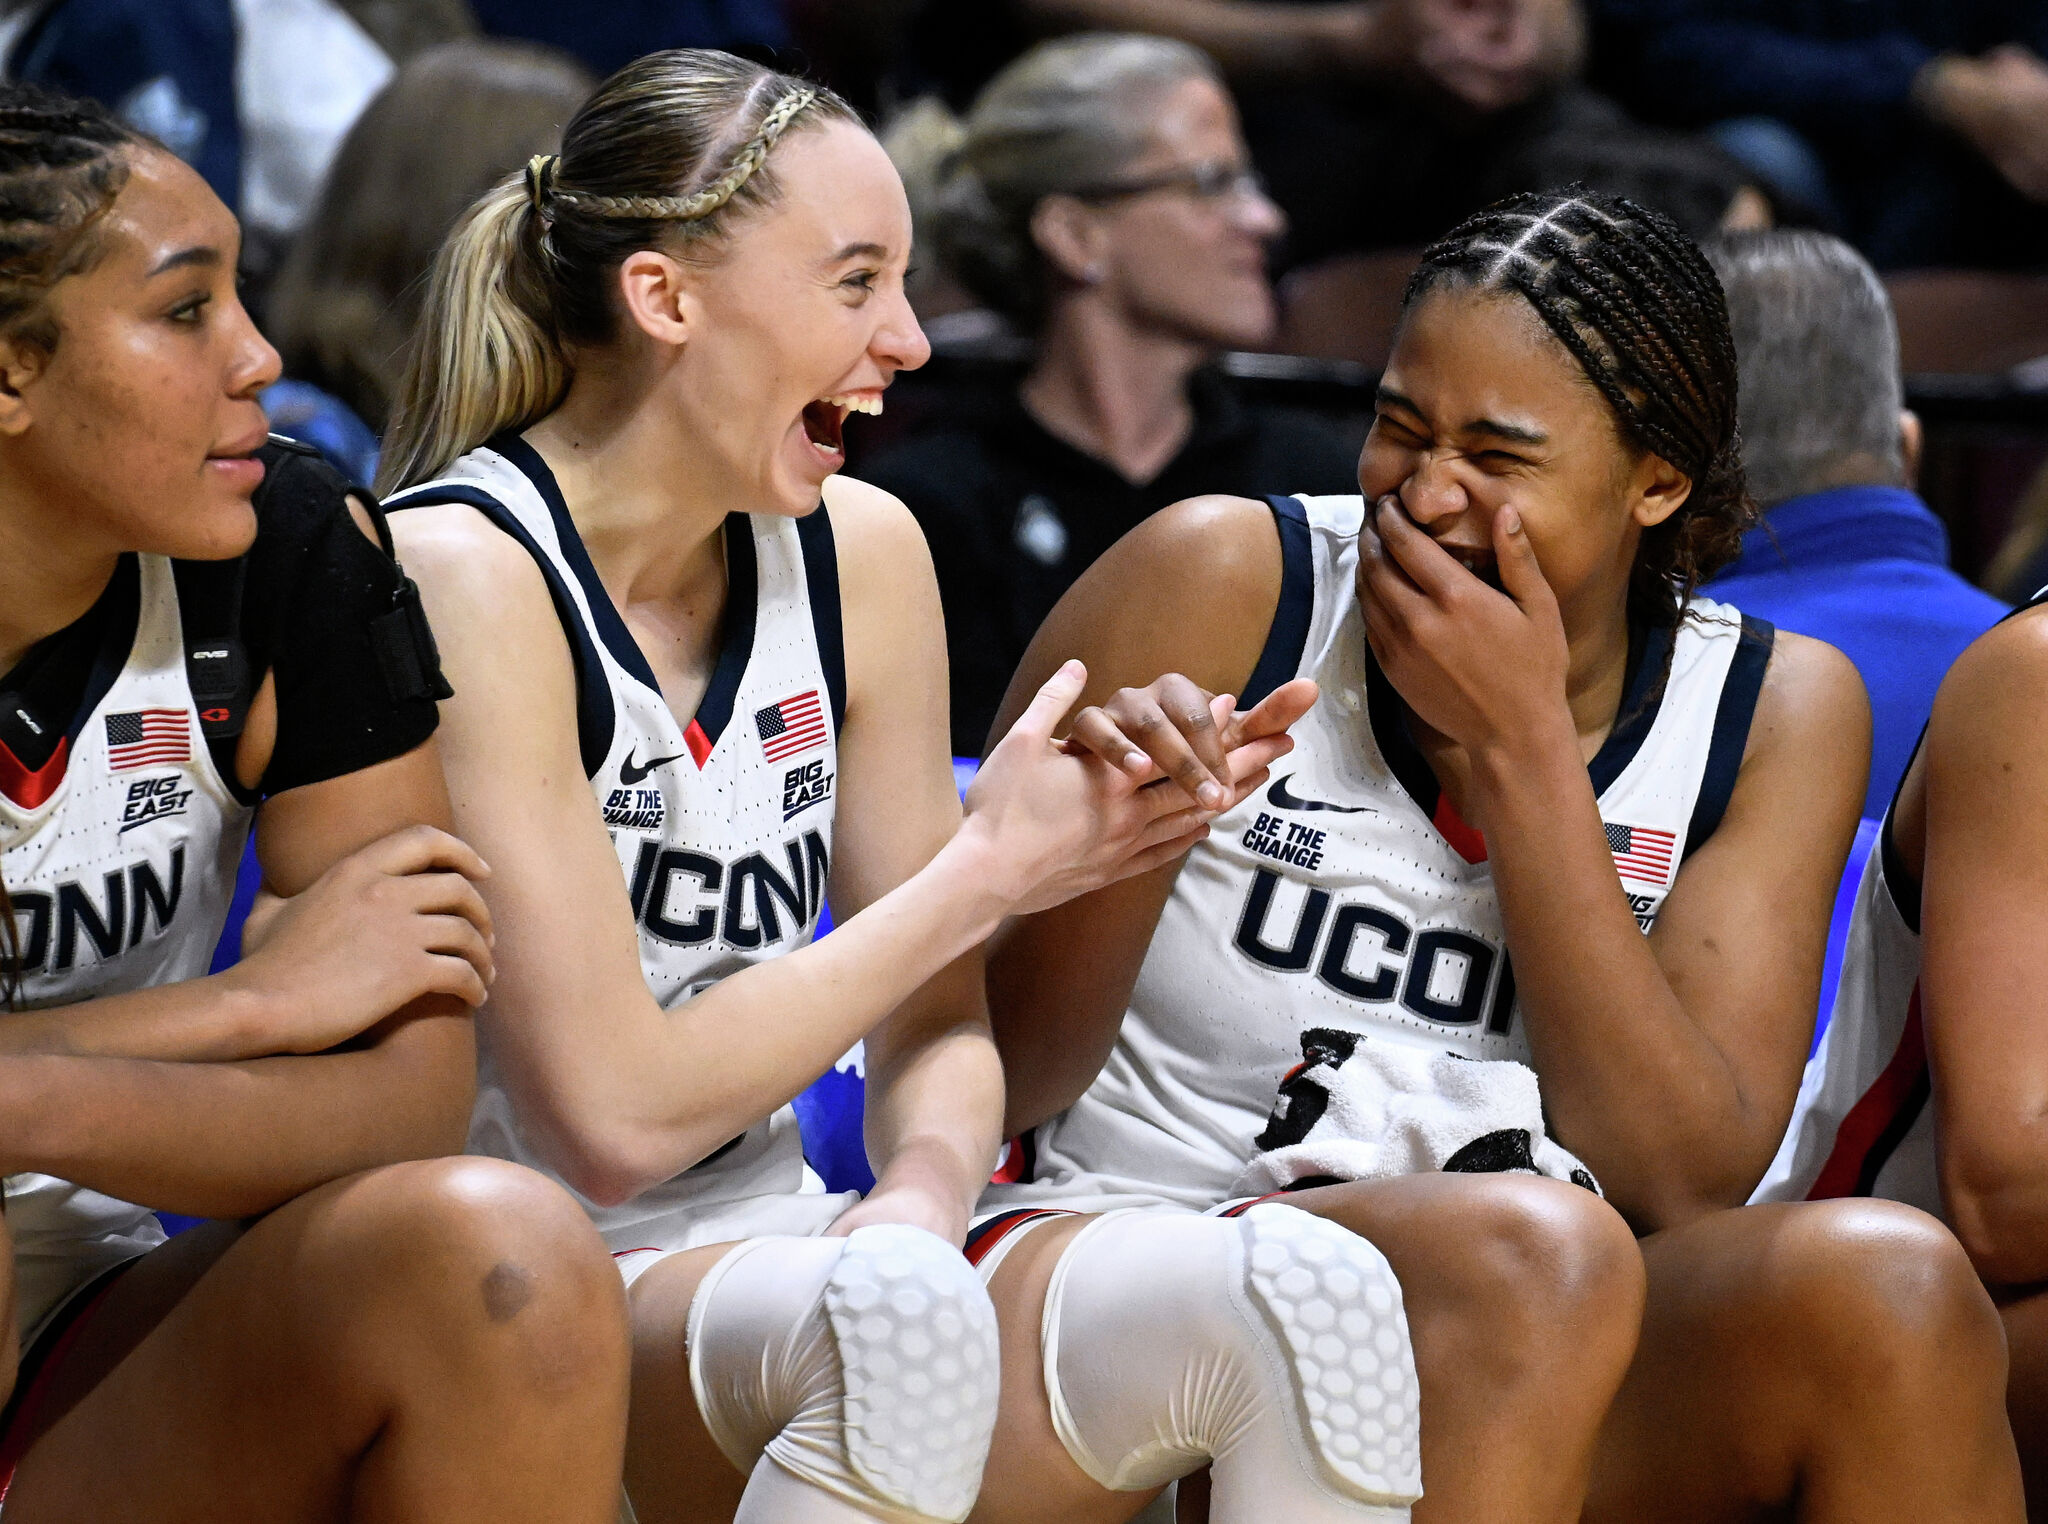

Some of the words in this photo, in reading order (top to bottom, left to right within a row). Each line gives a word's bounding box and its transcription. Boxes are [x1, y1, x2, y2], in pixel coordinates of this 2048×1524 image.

[128, 774, 182, 802] BIG
[783, 772, 835, 811] EAST
[786, 758, 824, 792] BIG
[122, 791, 193, 823] EAST
[606, 789, 633, 809] BE
[635, 790, 662, 809] THE
[1254, 812, 1283, 837] BE
[1286, 821, 1327, 850] THE
[1242, 828, 1324, 871] CHANGE
